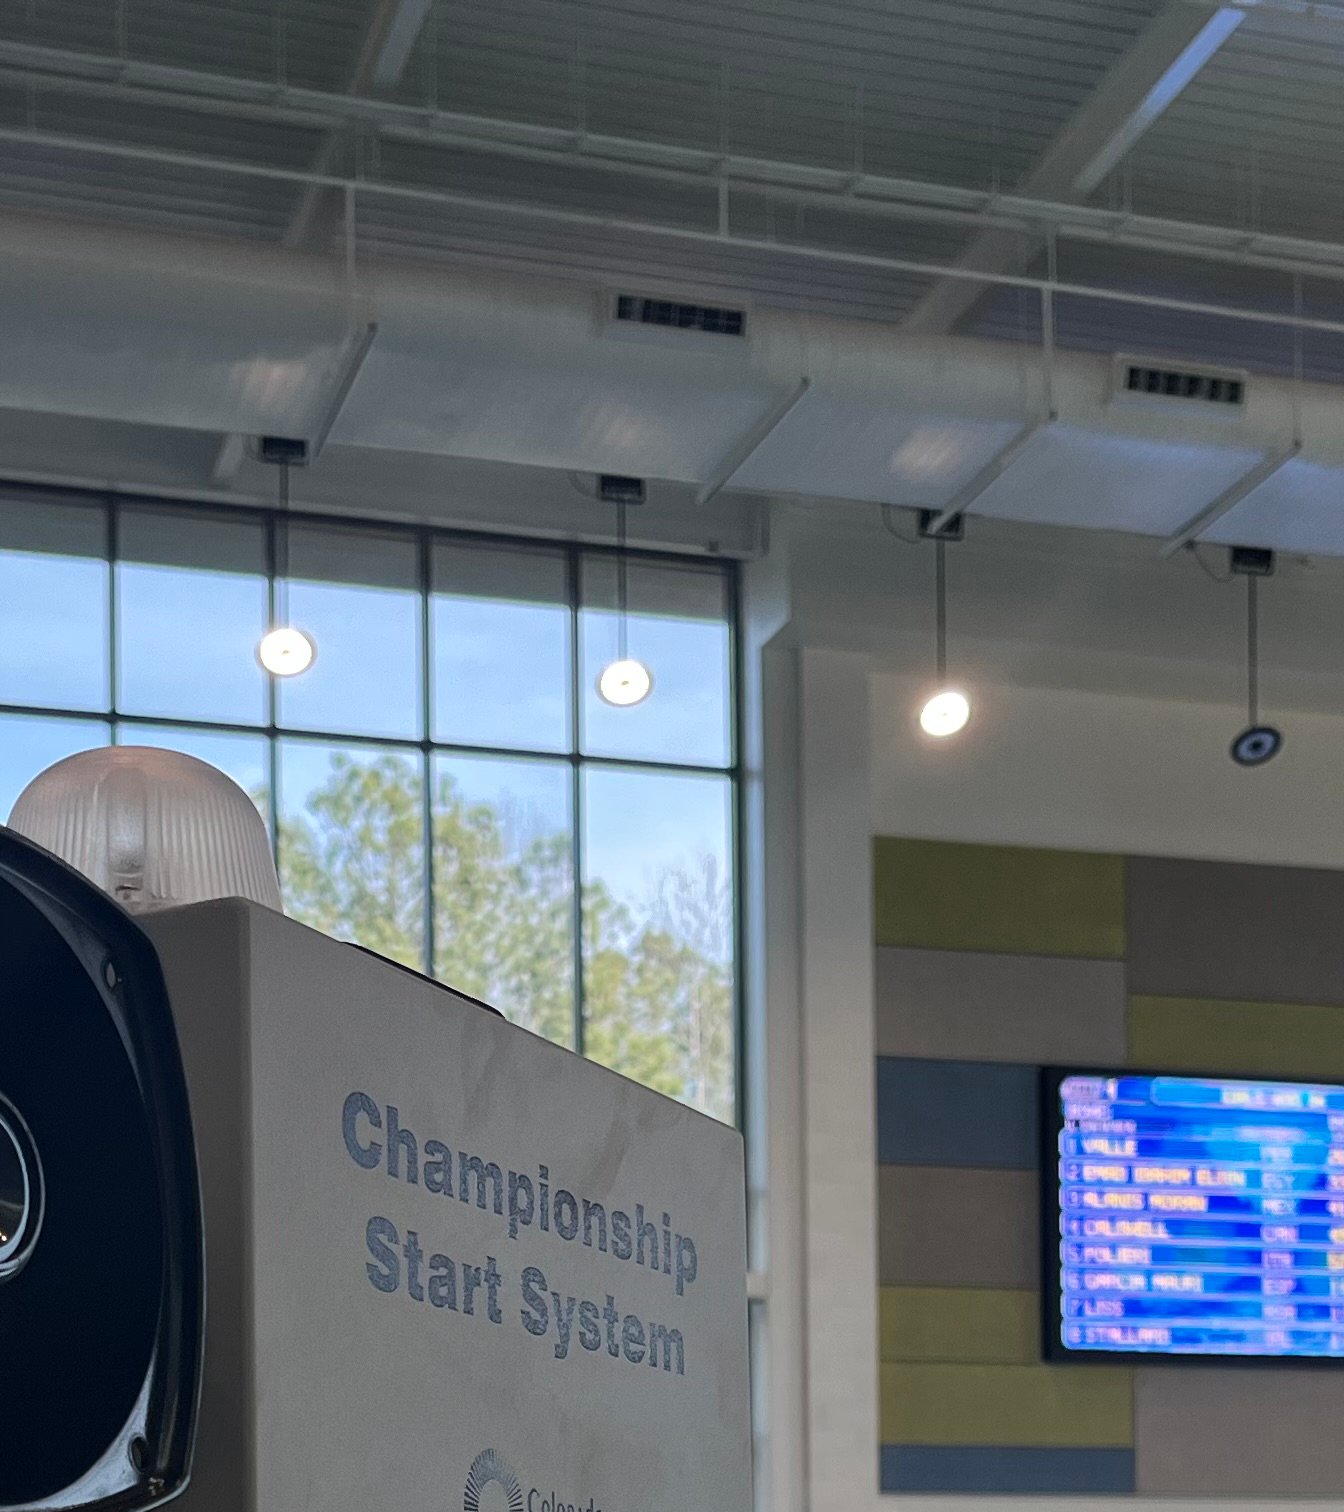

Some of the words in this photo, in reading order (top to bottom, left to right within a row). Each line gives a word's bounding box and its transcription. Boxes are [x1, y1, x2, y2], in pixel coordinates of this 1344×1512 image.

[342, 1091, 698, 1296] Championship
[366, 1216, 502, 1324] Start
[520, 1266, 684, 1375] System
